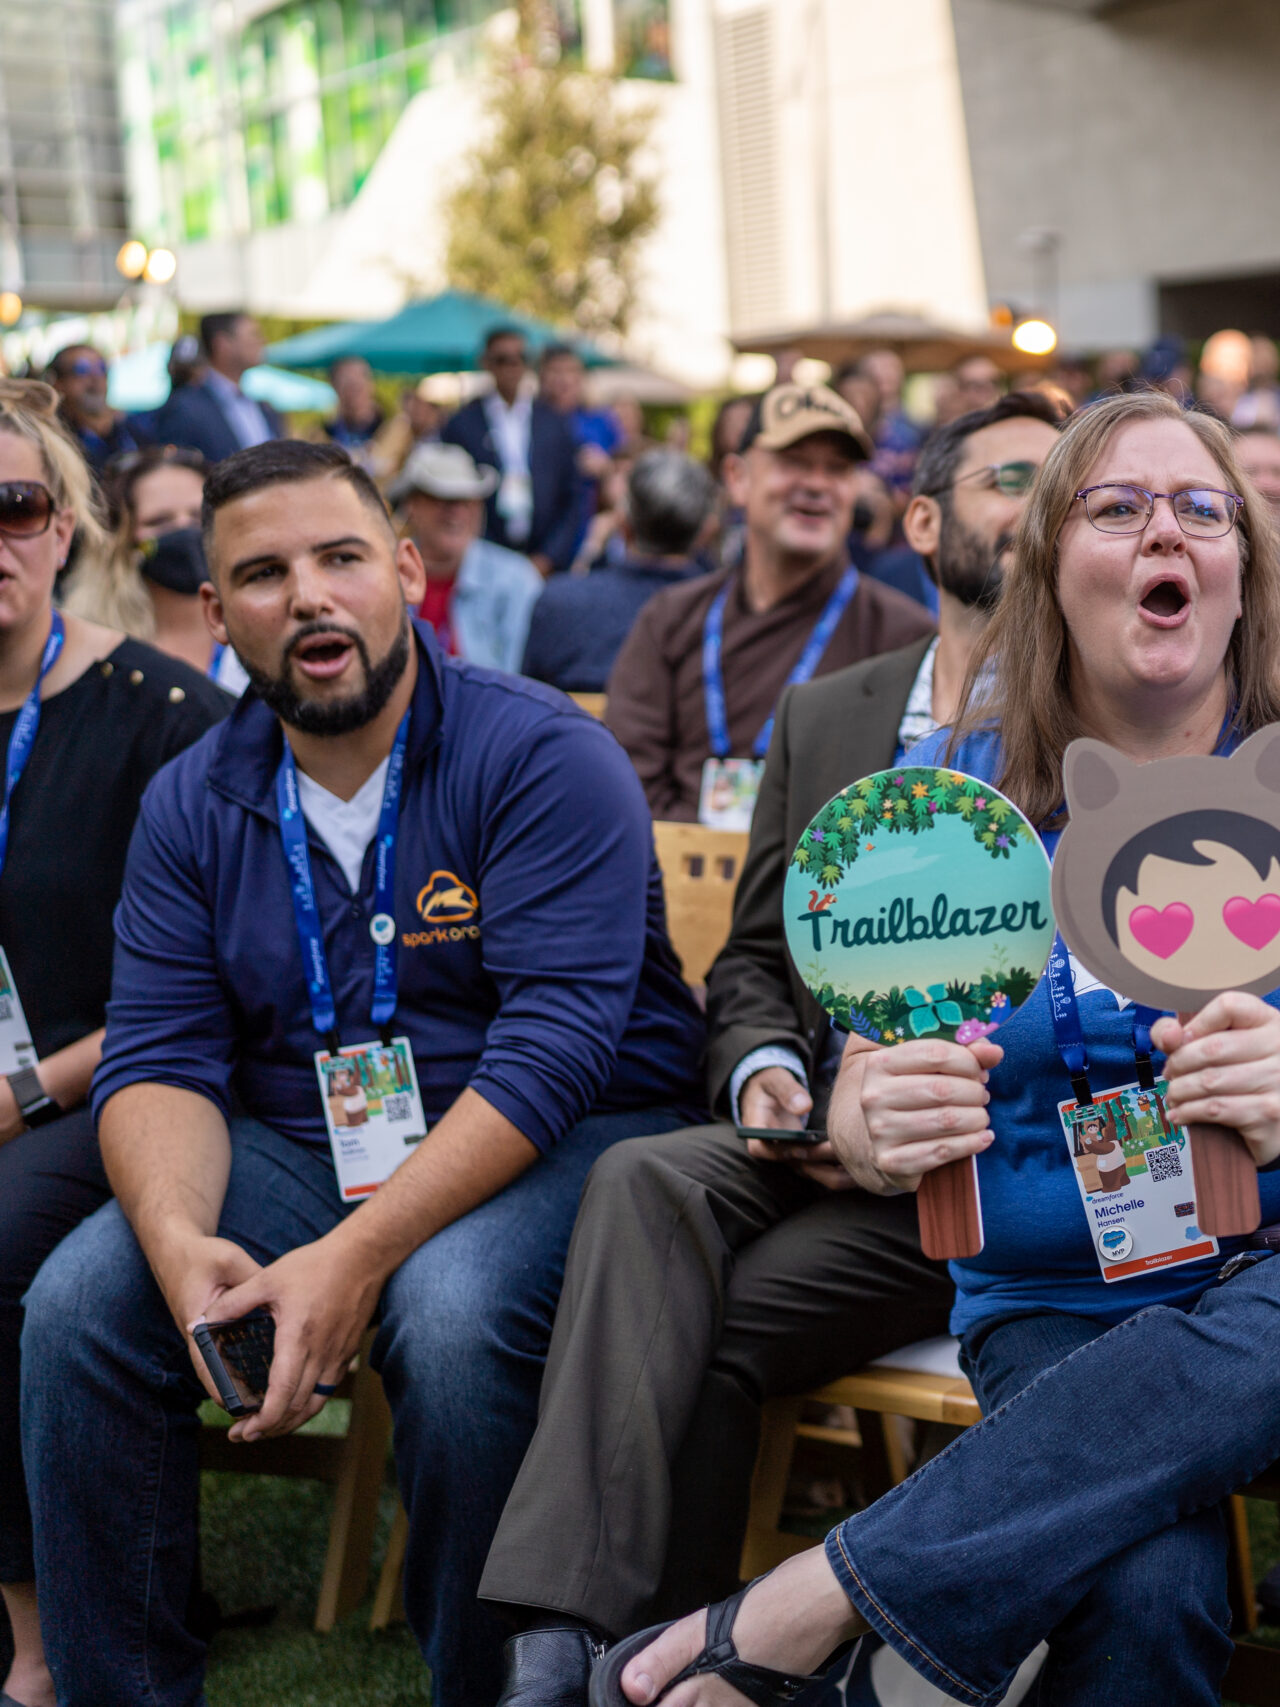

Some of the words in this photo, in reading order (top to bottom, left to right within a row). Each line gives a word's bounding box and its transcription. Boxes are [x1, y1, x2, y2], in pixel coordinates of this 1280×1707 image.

[797, 893, 1047, 952] Trailblazer
[1092, 1192, 1124, 1204] dreamforce
[1094, 1199, 1145, 1219] Michelle
[1097, 1216, 1125, 1229] Hansen
[1111, 1248, 1125, 1257] MVP
[1145, 1255, 1173, 1266] Trailblazer
